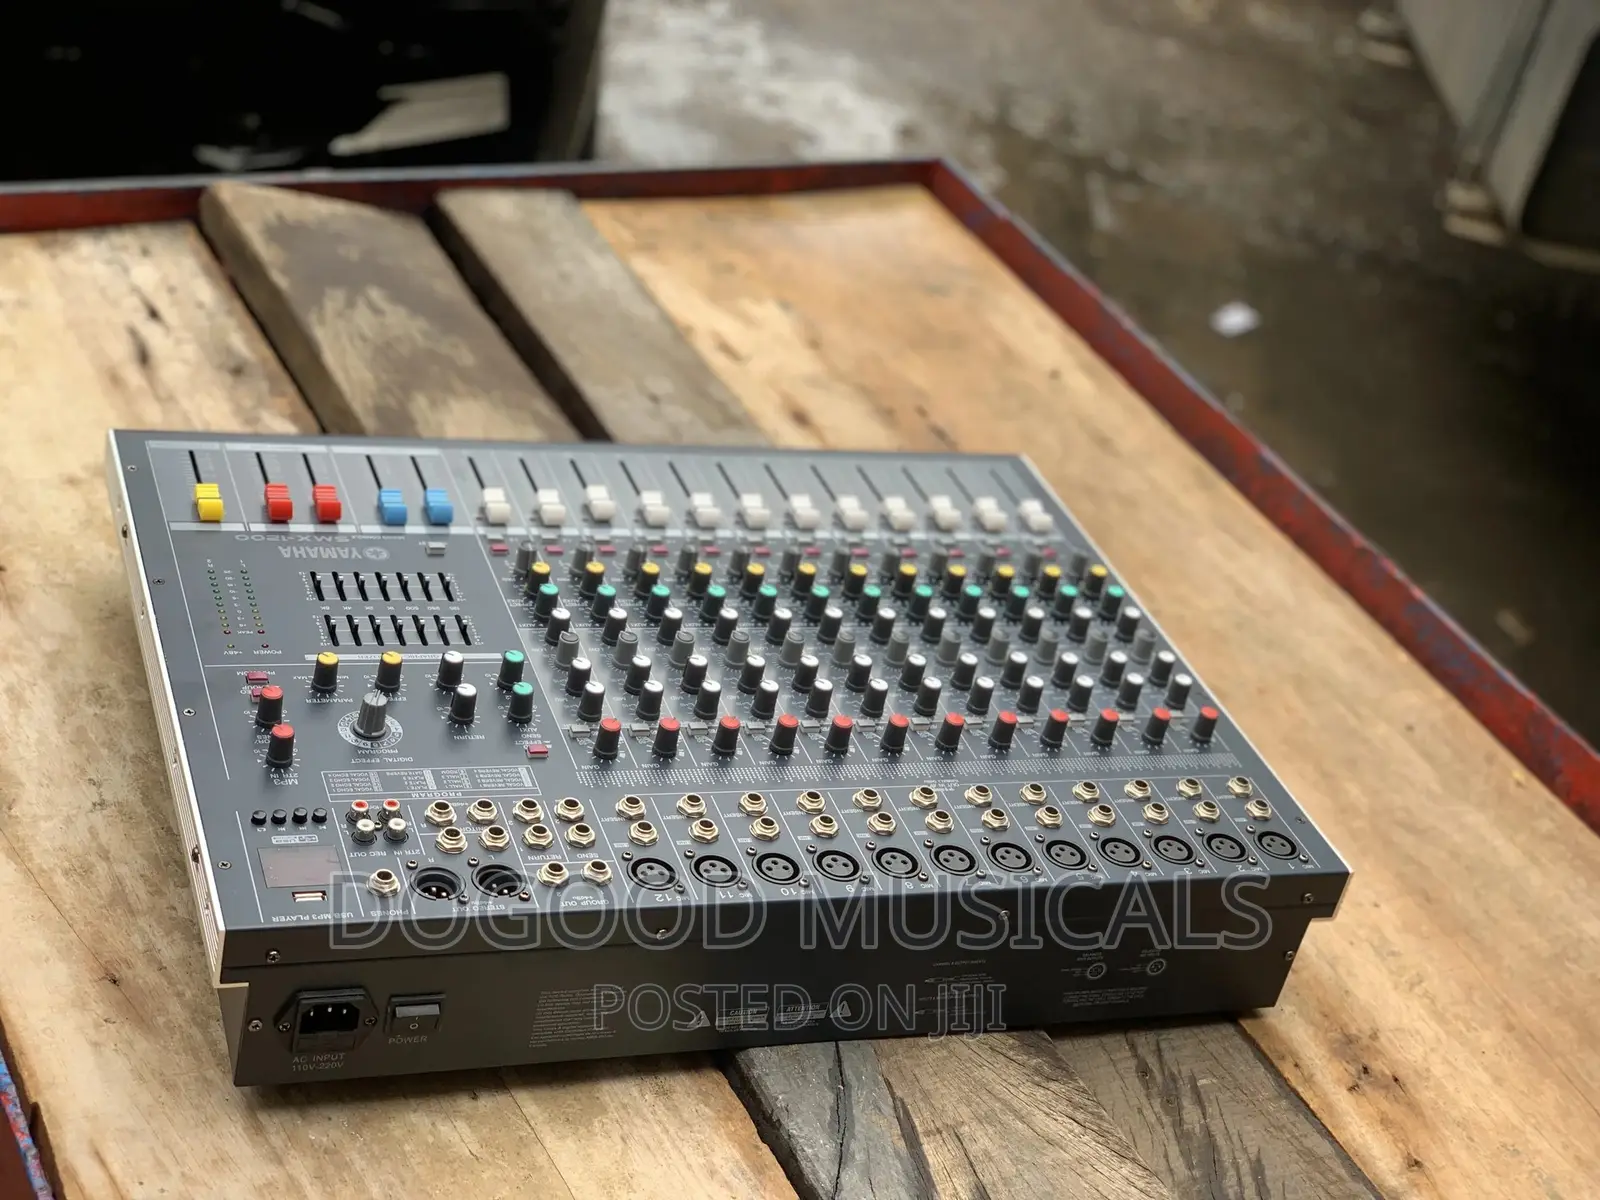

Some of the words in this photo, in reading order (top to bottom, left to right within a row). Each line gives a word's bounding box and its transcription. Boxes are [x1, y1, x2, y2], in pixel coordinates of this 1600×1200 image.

[234, 534, 350, 543] SMX-1200
[278, 545, 362, 560] YAMAHA
[453, 733, 486, 741] RETURN
[273, 778, 299, 786] MP3
[411, 791, 463, 799] PROGRAM
[311, 912, 332, 921] MP3
[369, 908, 409, 918] PHONES
[271, 914, 310, 923] PLAYER
[387, 1034, 429, 1046] POWER
[292, 1055, 308, 1064] AC
[312, 1052, 347, 1062] INPUT
